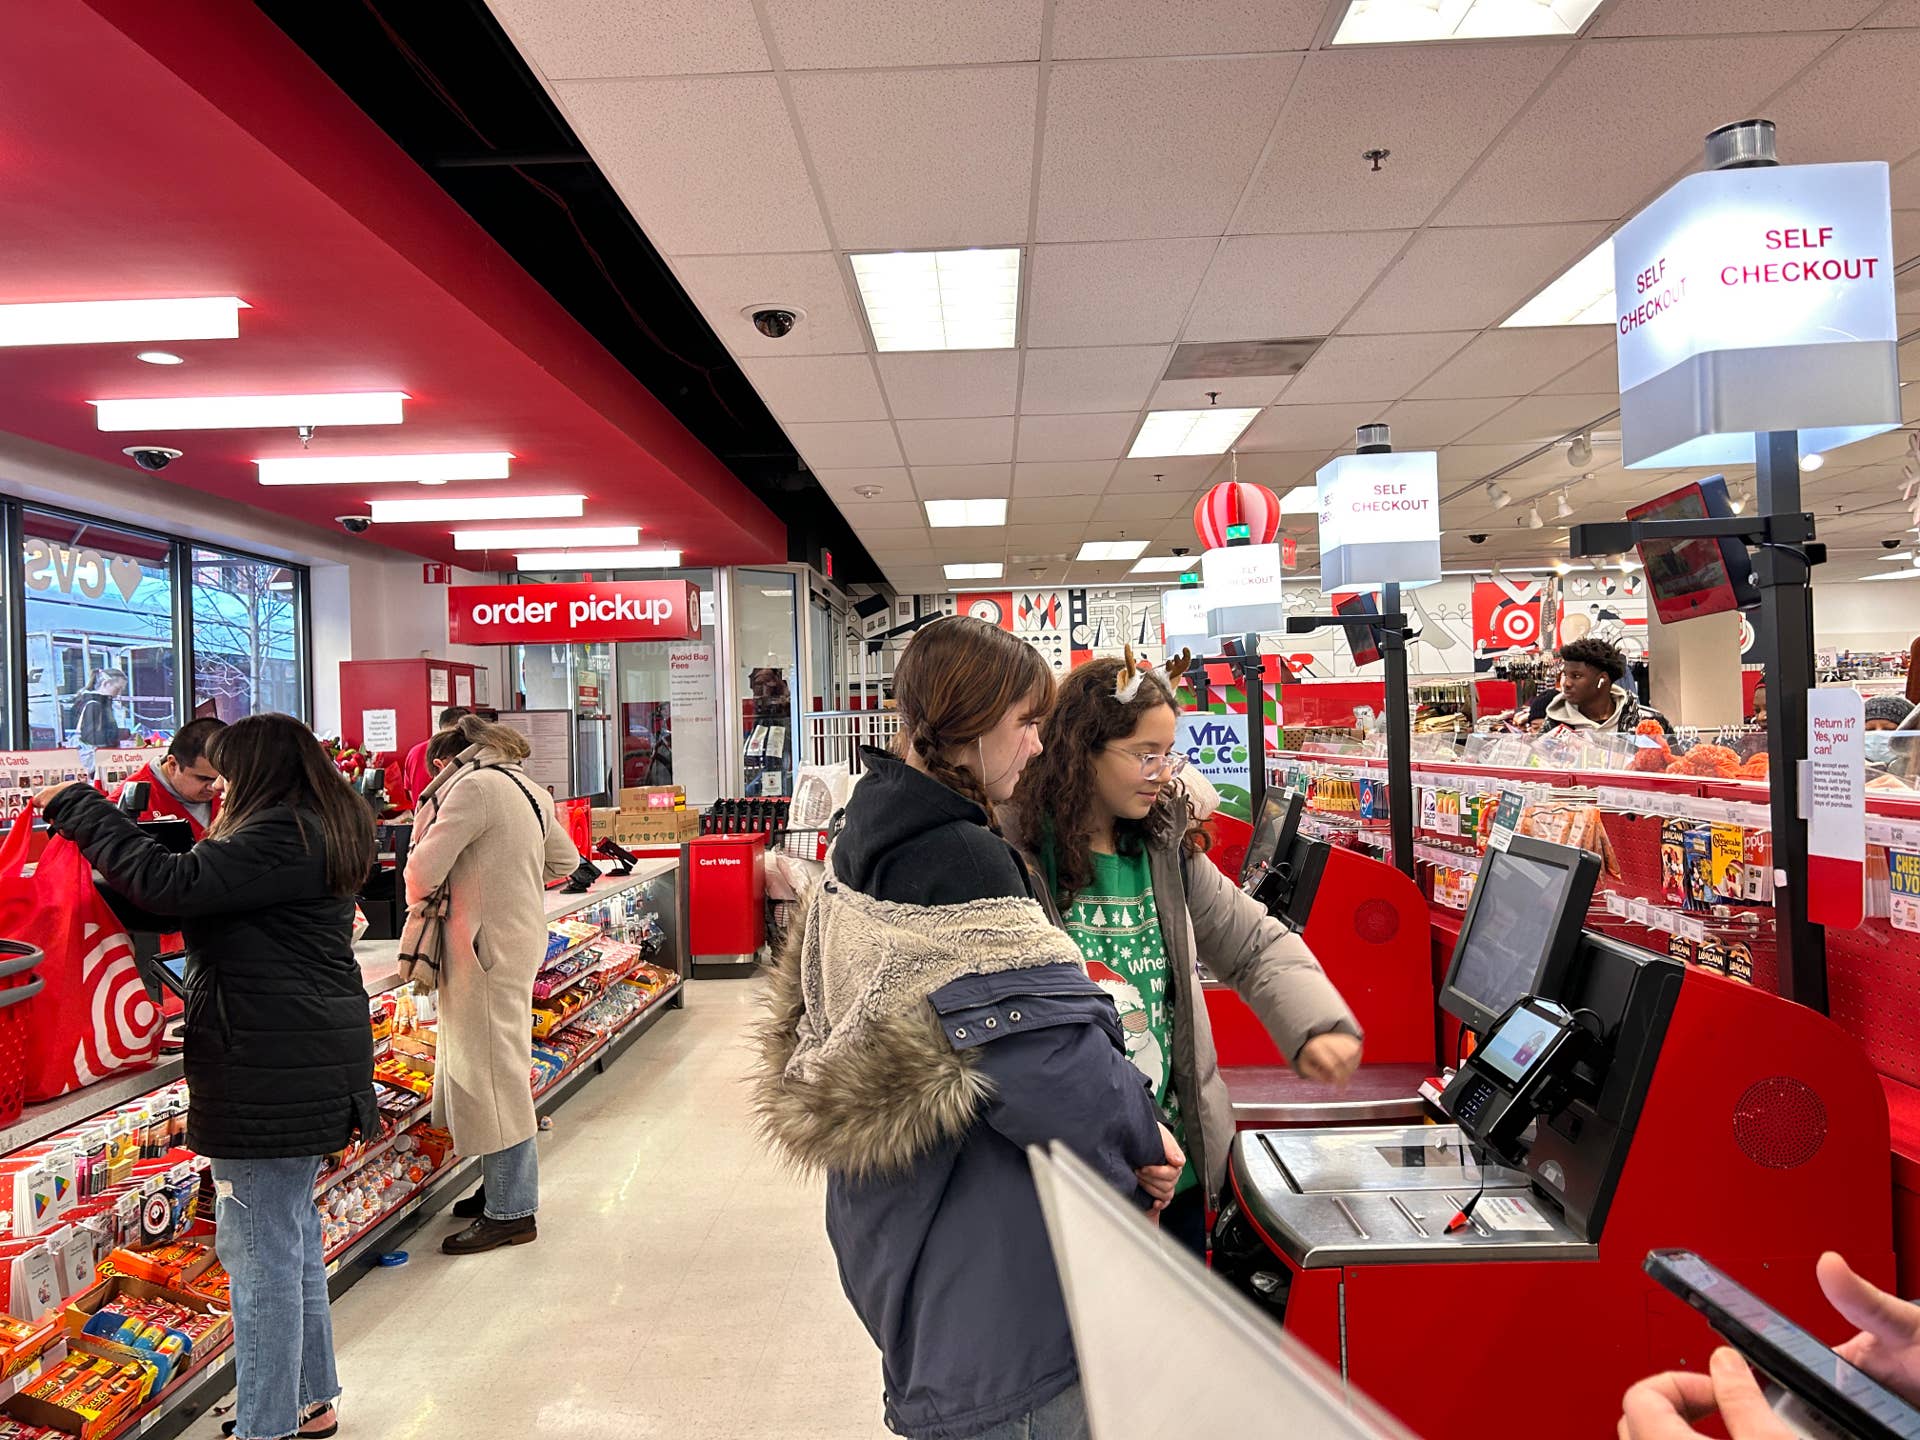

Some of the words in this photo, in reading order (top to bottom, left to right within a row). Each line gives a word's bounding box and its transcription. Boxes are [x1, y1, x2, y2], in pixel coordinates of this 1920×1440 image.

[1765, 227, 1833, 250] SELF
[1636, 258, 1666, 294] SELF
[1720, 258, 1879, 286] CHECKOUT
[1619, 277, 1687, 335] CHECKOUT
[1373, 484, 1407, 495] SELF
[1352, 499, 1429, 512] CHECKOUT
[472, 596, 557, 625] order
[569, 594, 673, 628] pickup
[693, 654, 709, 662] Bag
[1814, 717, 1843, 728] Return
[1844, 717, 1856, 728] it?
[1188, 722, 1240, 746] VITA
[1814, 731, 1831, 743] Yes,
[1832, 733, 1849, 744] you
[112, 754, 123, 763] Gift
[124, 753, 143, 762] Cards
[1186, 746, 1248, 764] COCO
[1814, 745, 1832, 755] can!
[6, 756, 30, 766] Cards
[1223, 766, 1249, 774] Wate
[1712, 833, 1741, 848] Cheesecake
[1744, 835, 1765, 852] ppy
[1720, 844, 1741, 858] Factory
[718, 858, 741, 866] Wipes
[1895, 854, 1920, 876] CHEE
[1891, 871, 1903, 892] TO
[1904, 874, 1920, 895] YO
[1150, 977, 1167, 994] My
[57, 1389, 82, 1407] eese's
